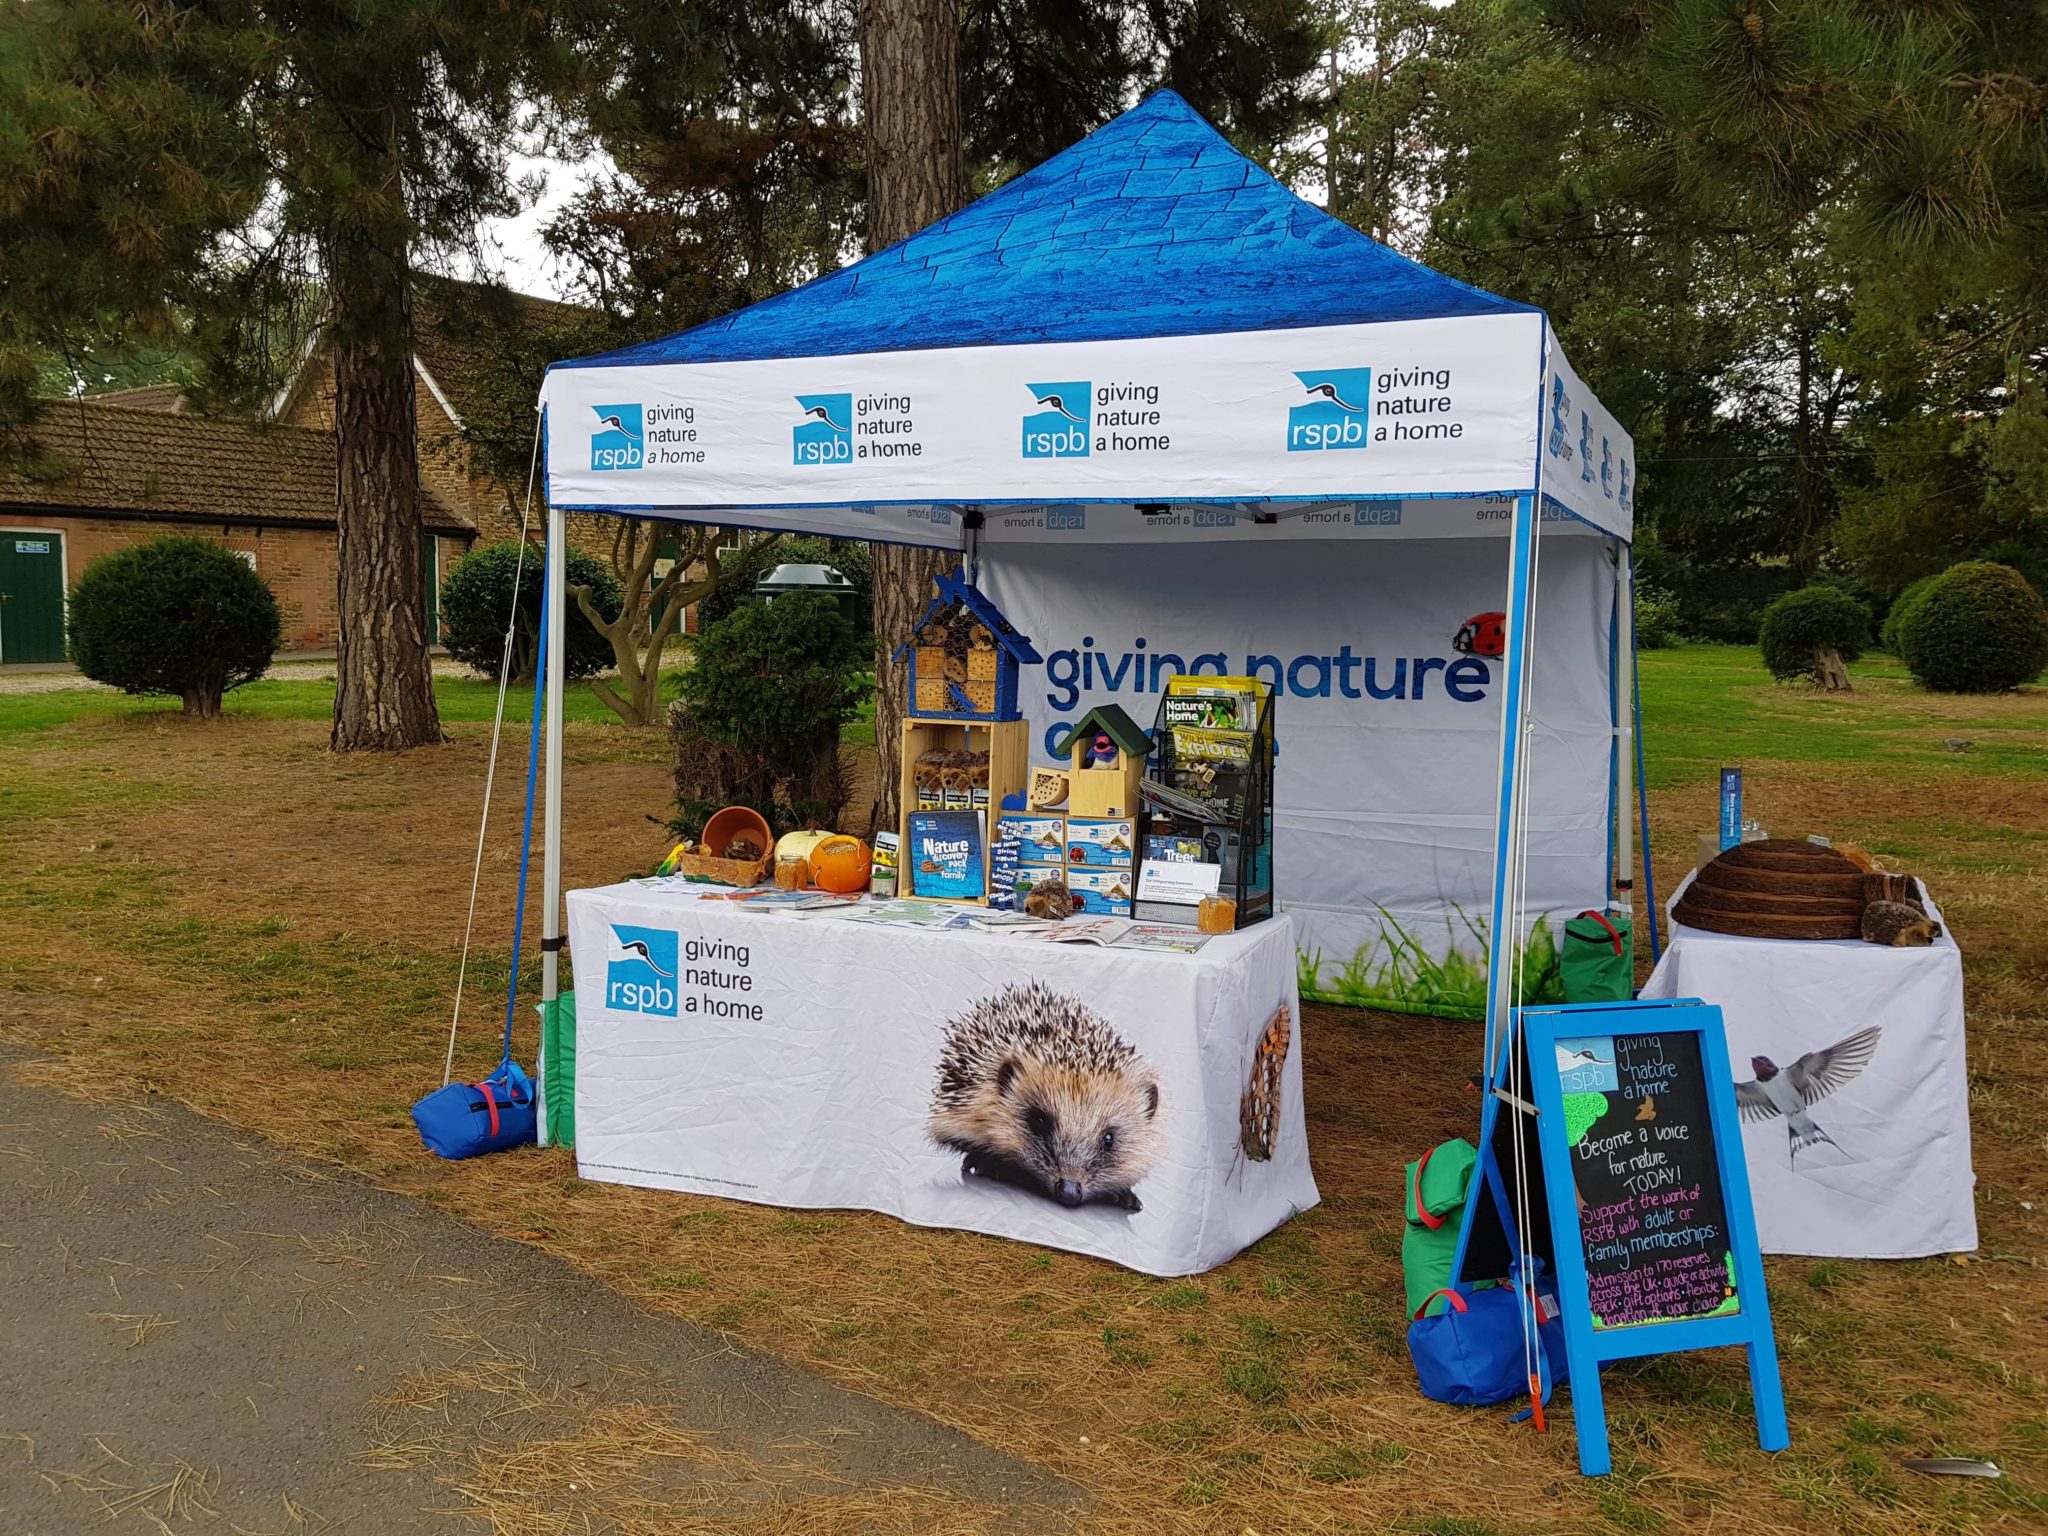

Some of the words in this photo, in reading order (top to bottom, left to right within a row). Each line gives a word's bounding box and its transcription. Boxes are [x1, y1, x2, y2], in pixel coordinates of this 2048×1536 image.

[1378, 366, 1450, 393] giving
[857, 393, 910, 416] giving
[1097, 382, 1158, 406] giving
[1377, 396, 1451, 415] nature
[647, 404, 694, 425] giving
[858, 419, 912, 434] nature
[1097, 410, 1160, 426] nature
[648, 428, 696, 443] nature
[1027, 425, 1085, 457] rspb
[1096, 437, 1106, 450] a
[1113, 432, 1170, 450] home
[1293, 416, 1362, 450] rspb
[1375, 427, 1387, 441] a
[1395, 422, 1462, 440] home
[594, 442, 640, 470] rspb
[648, 452, 656, 463] a
[660, 448, 705, 463] home
[798, 434, 848, 464] rspb
[858, 445, 867, 458] a
[872, 440, 922, 457] home
[1246, 646, 1490, 701] nature
[1166, 701, 1212, 710] Nature's
[1166, 711, 1198, 720] Home
[923, 838, 968, 855] Nature
[941, 871, 966, 880] family
[949, 860, 966, 868] pack
[685, 936, 750, 967] giving
[686, 968, 752, 991] nature
[612, 979, 673, 1012] rspb
[685, 997, 697, 1012] a
[704, 994, 763, 1021] home
[1617, 1036, 1663, 1071] giving
[1560, 1065, 1604, 1092] rspb
[1630, 1060, 1678, 1080] nature
[1624, 1085, 1633, 1100] a
[1636, 1080, 1670, 1098] home
[1577, 1132, 1633, 1160] Become
[1639, 1128, 1648, 1142] a
[1655, 1120, 1689, 1140] voice
[1608, 1151, 1627, 1176] for
[1630, 1147, 1668, 1171] nature
[1623, 1165, 1681, 1196] TODAY!
[1582, 1196, 1636, 1227] Support
[1640, 1194, 1659, 1209] the
[1662, 1186, 1688, 1204] work
[1690, 1183, 1700, 1203] of
[1583, 1224, 1615, 1244] RSPB
[1619, 1215, 1640, 1235] with
[1645, 1208, 1675, 1229] adult
[1680, 1208, 1694, 1220] or
[1588, 1238, 1630, 1270] family
[1631, 1224, 1718, 1252] memberships:
[1589, 1270, 1642, 1288] Admission
[1644, 1264, 1654, 1277] to
[1656, 1259, 1672, 1272] 170
[1674, 1252, 1710, 1268] reserves
[1591, 1286, 1622, 1302] across
[1624, 1280, 1640, 1294] the
[1663, 1271, 1689, 1291] guide
[1690, 1271, 1698, 1280] or
[1591, 1299, 1618, 1315] pack
[1624, 1291, 1644, 1314] gift
[1644, 1288, 1681, 1309] options
[1686, 1280, 1720, 1296] flexible
[1603, 1309, 1647, 1326] donation
[1651, 1302, 1662, 1318] of
[1667, 1302, 1689, 1318] your
[1693, 1296, 1720, 1312] choice
